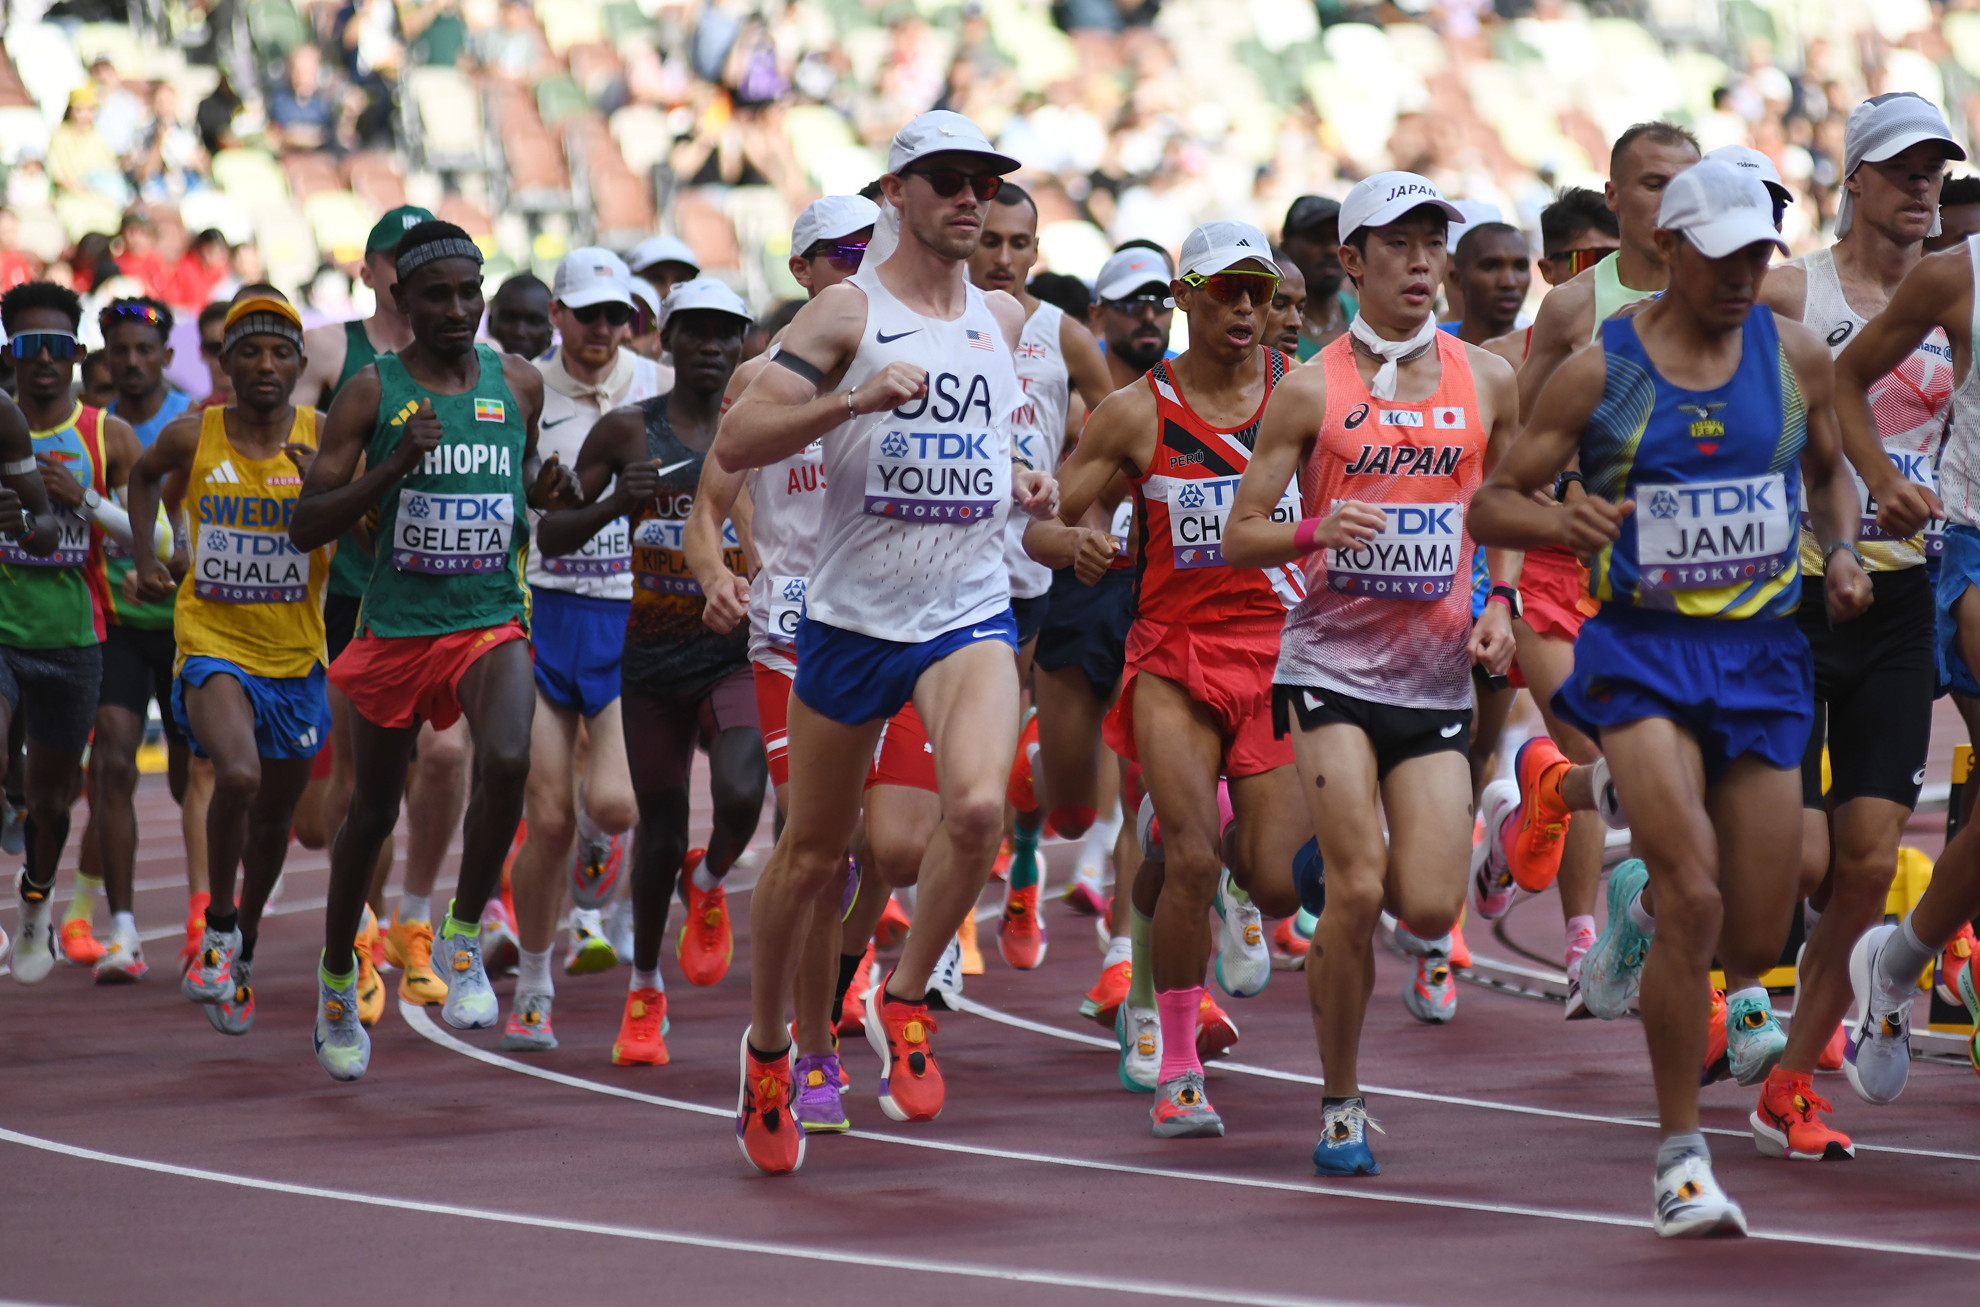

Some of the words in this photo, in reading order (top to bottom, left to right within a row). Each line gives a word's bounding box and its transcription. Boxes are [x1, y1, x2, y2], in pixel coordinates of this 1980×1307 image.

[1386, 184, 1437, 202] JAPAN
[892, 371, 991, 427] USA
[1383, 411, 1421, 426] ACN
[402, 443, 512, 479] HIOPIA
[909, 432, 991, 461] TDK
[1169, 449, 1205, 469] PERÚ
[1345, 444, 1464, 477] JAPAN
[877, 464, 994, 496] YOUNG
[199, 494, 299, 528] SWEDE
[430, 497, 505, 521] TDK
[1678, 481, 1777, 519] TDK
[229, 531, 300, 556] TDK
[402, 524, 504, 552] GELETA
[1666, 521, 1765, 560] JAMI
[203, 557, 301, 584] CHALA
[1335, 539, 1454, 573] KOYAMA
